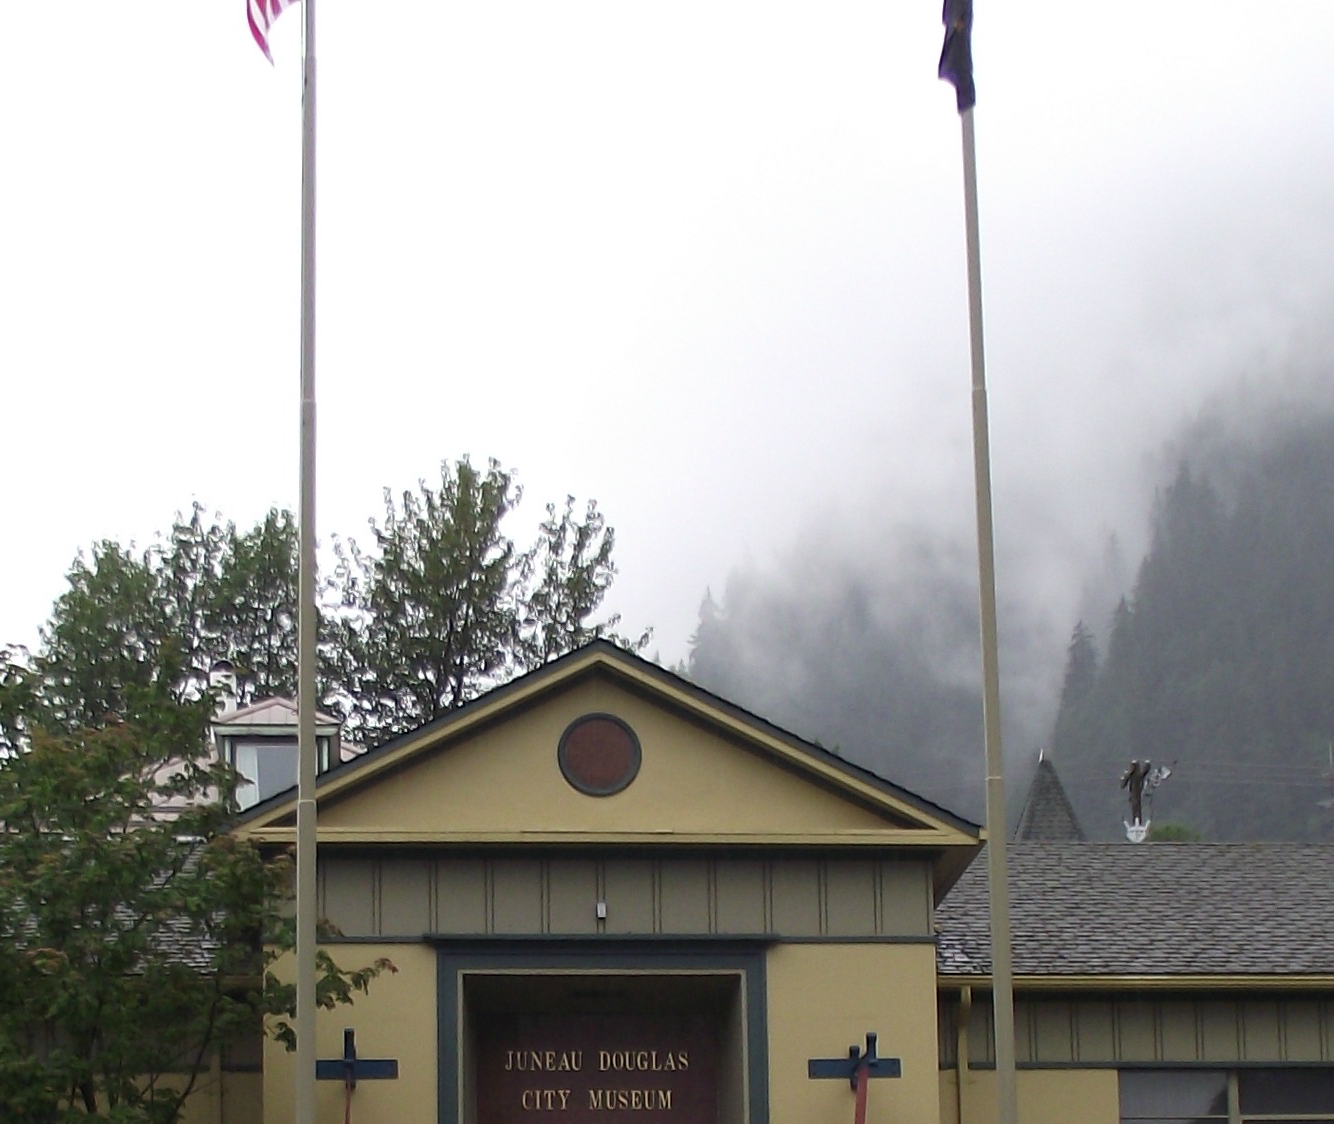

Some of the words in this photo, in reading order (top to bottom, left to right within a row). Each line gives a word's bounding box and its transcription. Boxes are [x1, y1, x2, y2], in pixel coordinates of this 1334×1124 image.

[505, 1051, 583, 1072] JUNEAU
[599, 1051, 690, 1072] DOUGLAS
[522, 1090, 572, 1110] CITY
[589, 1089, 673, 1110] MUSEUM
